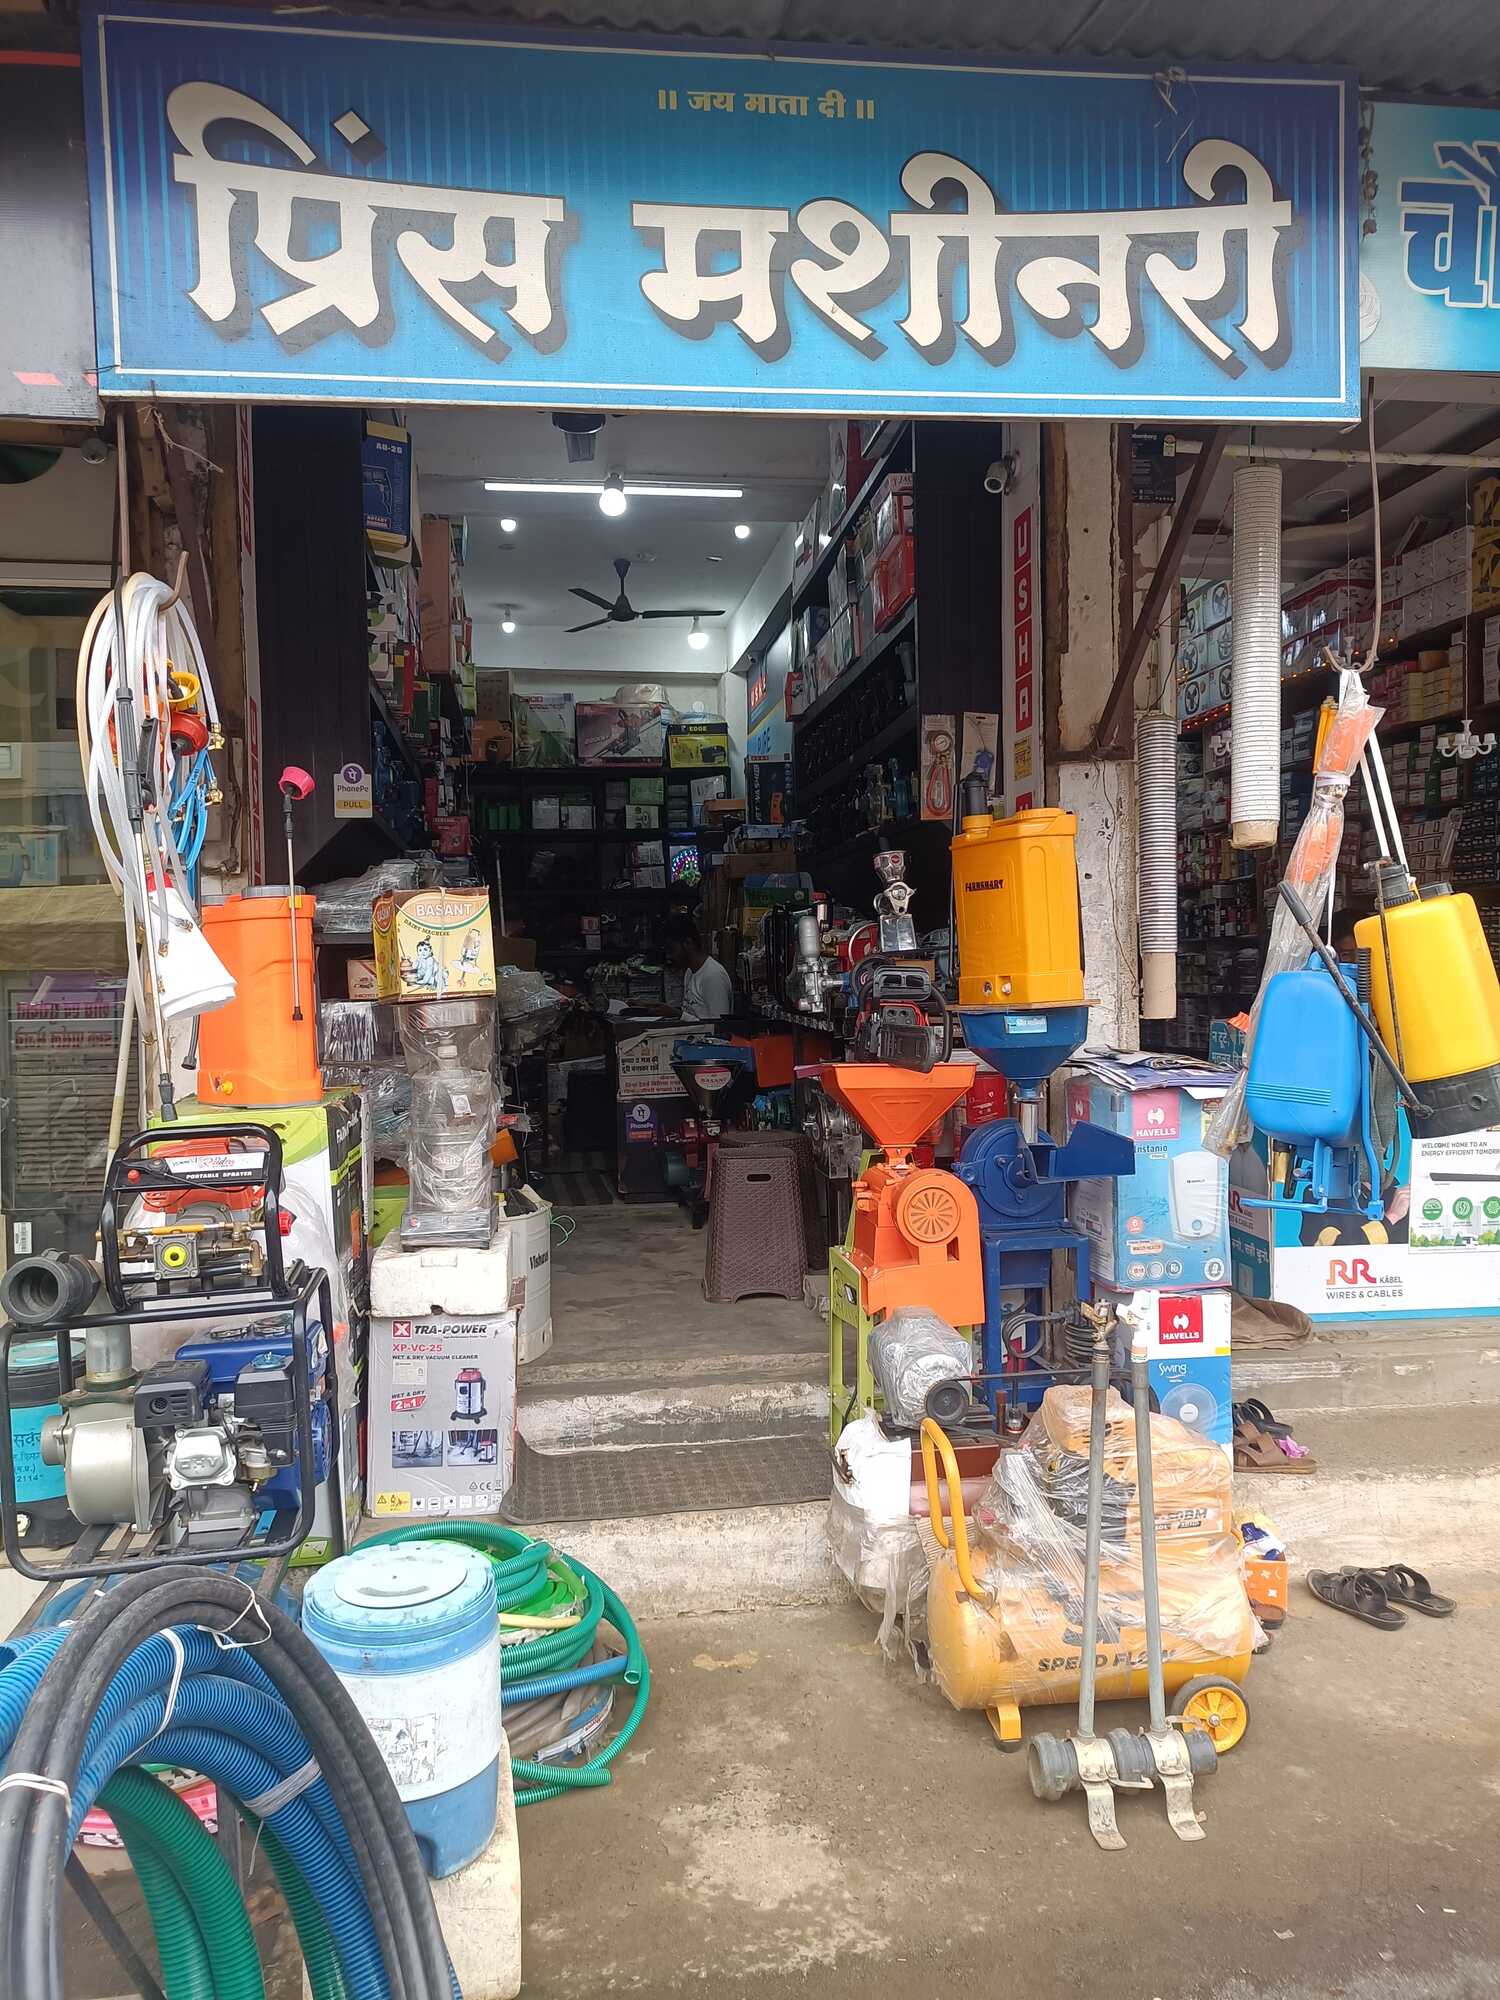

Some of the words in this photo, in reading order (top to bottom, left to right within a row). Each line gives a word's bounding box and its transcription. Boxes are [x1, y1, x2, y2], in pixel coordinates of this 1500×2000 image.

[687, 91, 736, 113] जय
[743, 93, 810, 116] माता
[817, 89, 847, 119] दी
[166, 81, 564, 344] प्रिंस
[632, 138, 1292, 361] मशीनरी
[1016, 512, 1031, 728] USHA
[337, 784, 369, 793] PhonePe
[416, 903, 472, 917] BASANT
[630, 1122, 654, 1130] PhonePe
[1136, 1128, 1177, 1137] HAVELLS
[186, 1172, 219, 1180] PORTABLE
[1326, 1258, 1377, 1285] RR
[1326, 1291, 1357, 1300] WIRES
[1366, 1289, 1404, 1298] CABLES
[1162, 1331, 1200, 1341] HAVELLS
[392, 1343, 443, 1353] XP-VC-25
[1158, 1362, 1187, 1376] Swing
[1038, 1654, 1108, 1672] SPED
